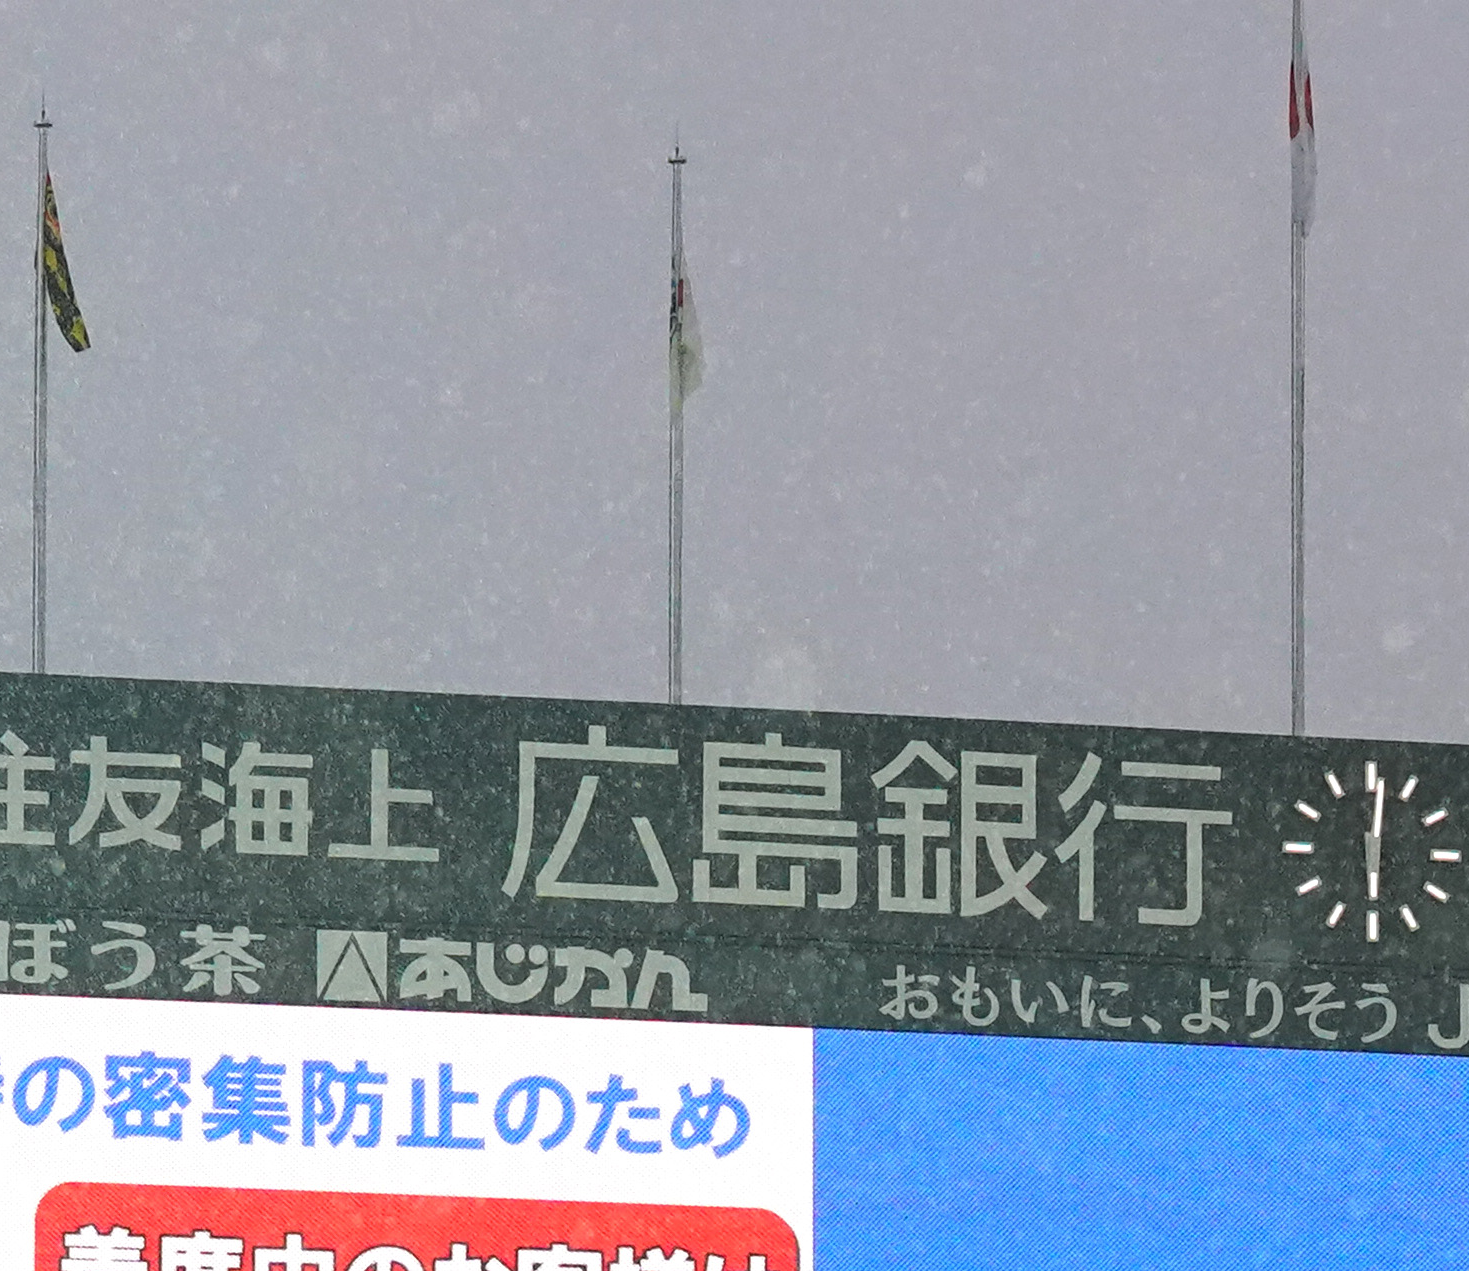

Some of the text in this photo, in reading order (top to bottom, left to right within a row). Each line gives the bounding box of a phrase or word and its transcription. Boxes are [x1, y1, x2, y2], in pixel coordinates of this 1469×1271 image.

[501, 727, 1234, 927] 広島銀行
[400, 938, 708, 1012] あじかん
[883, 964, 1398, 1042] おもいに、よりそう
